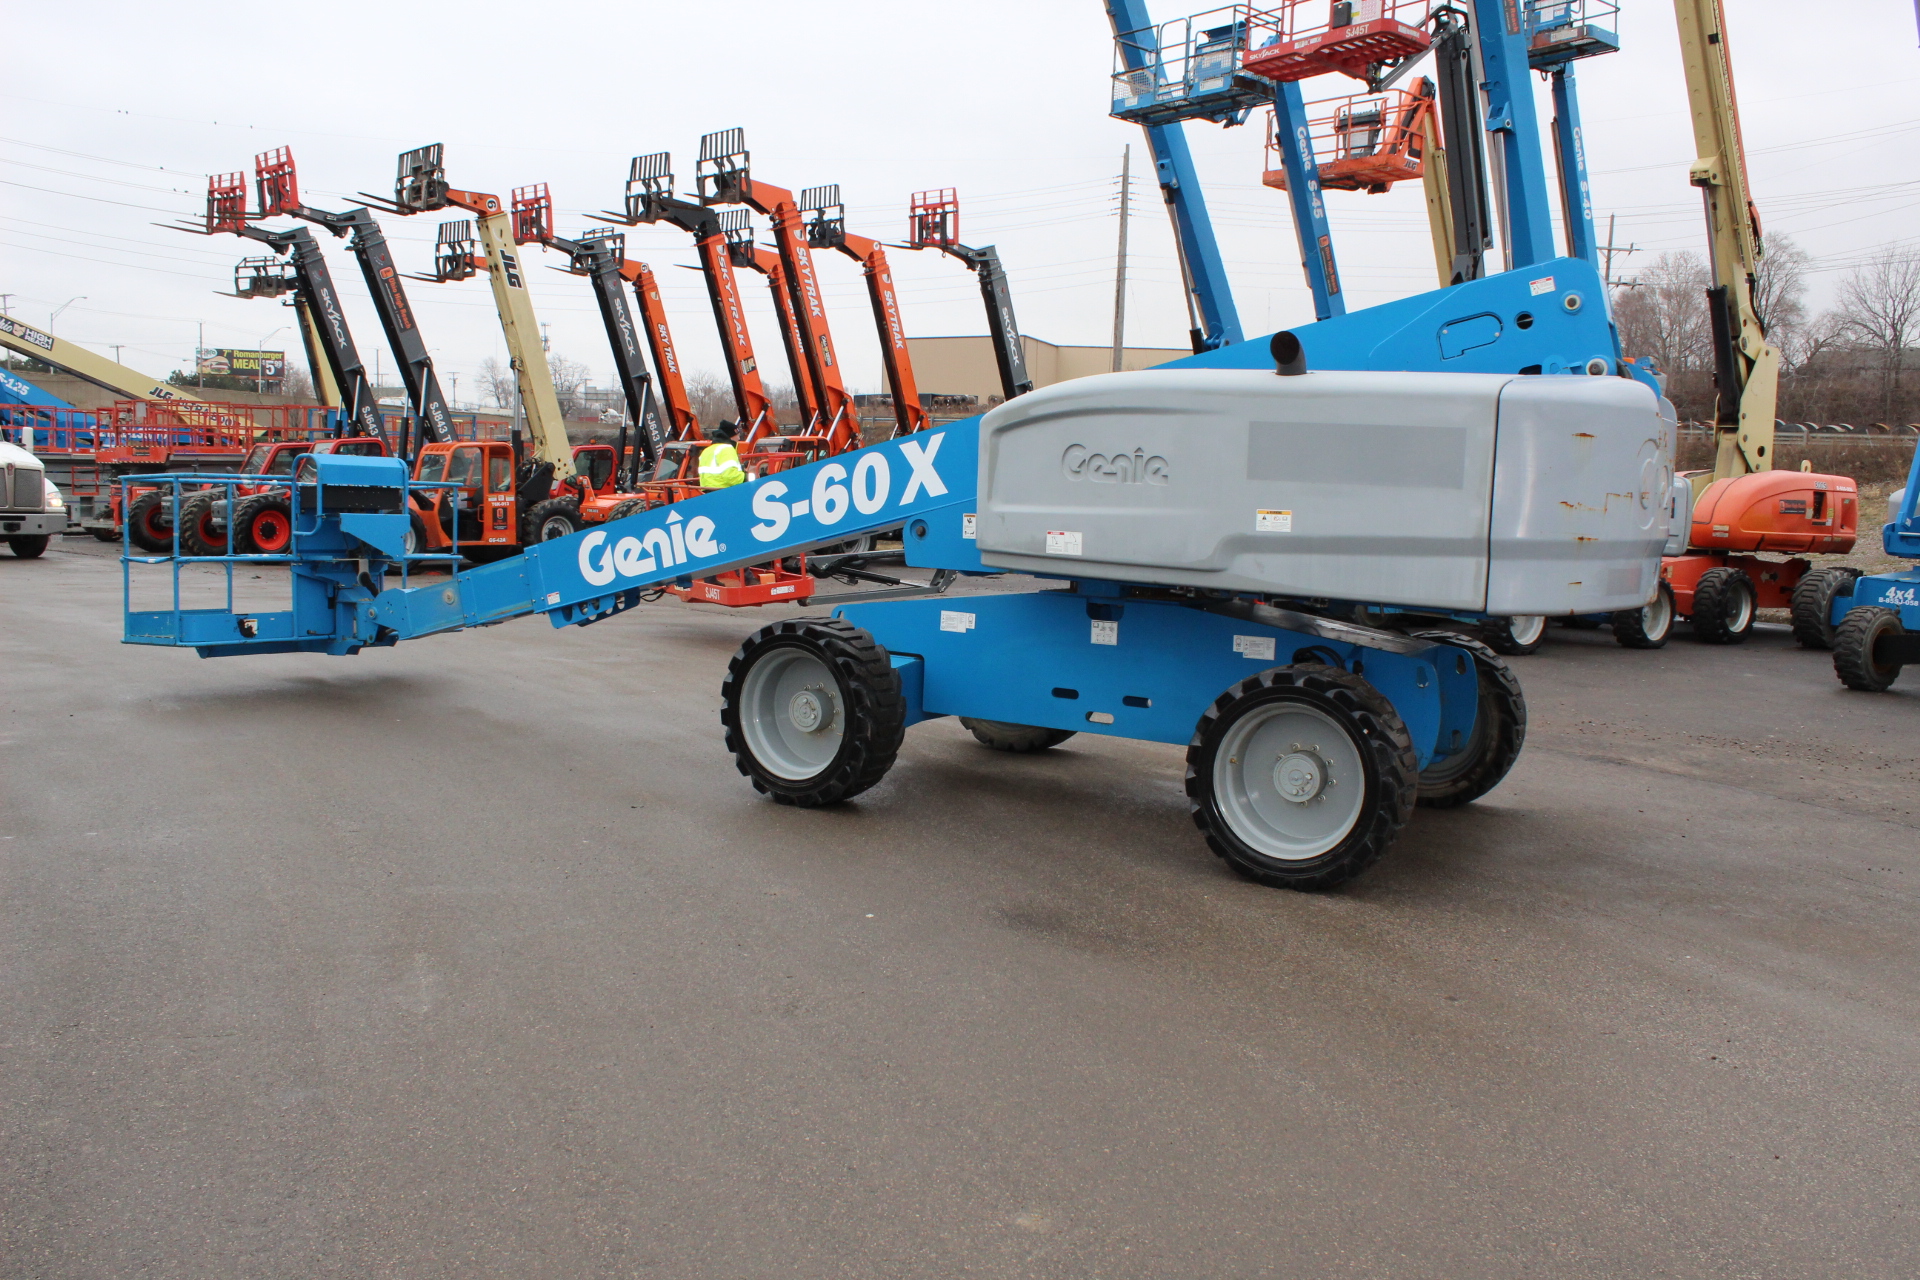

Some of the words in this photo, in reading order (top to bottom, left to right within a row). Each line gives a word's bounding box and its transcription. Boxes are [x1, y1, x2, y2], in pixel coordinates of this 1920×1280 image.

[1345, 24, 1370, 38] SJ45T
[1249, 47, 1280, 61] SKYJACK
[1297, 126, 1313, 173] Genie
[1308, 180, 1324, 219] S-45
[1404, 160, 1418, 171] JLG
[1573, 126, 1585, 171] Genie
[1580, 181, 1592, 220] S-40
[499, 249, 524, 290] JLG
[796, 246, 822, 318] SKYTRAK
[320, 287, 348, 350] SKYJACK
[718, 255, 747, 347] SKYTRAK
[26, 328, 53, 345] HIGH
[614, 297, 636, 357] SKYJACK
[883, 290, 904, 350] SKYTRAK
[1002, 306, 1020, 367] SKYJACK
[24, 335, 51, 350] REACH
[657, 323, 670, 346] SKY
[664, 347, 678, 374] TRAK
[233, 358, 260, 370] MEAL
[0, 372, 30, 396] S-125
[148, 386, 175, 400] JLG
[361, 405, 379, 436] SJ643
[429, 401, 448, 434] SJ843
[646, 412, 661, 442] SJ643
[1061, 443, 1169, 487] Genie
[750, 451, 890, 542] S-60
[898, 432, 949, 507] X
[578, 509, 720, 587] Genie
[705, 586, 721, 601] SJ45T
[1885, 586, 1915, 601] 4x4
